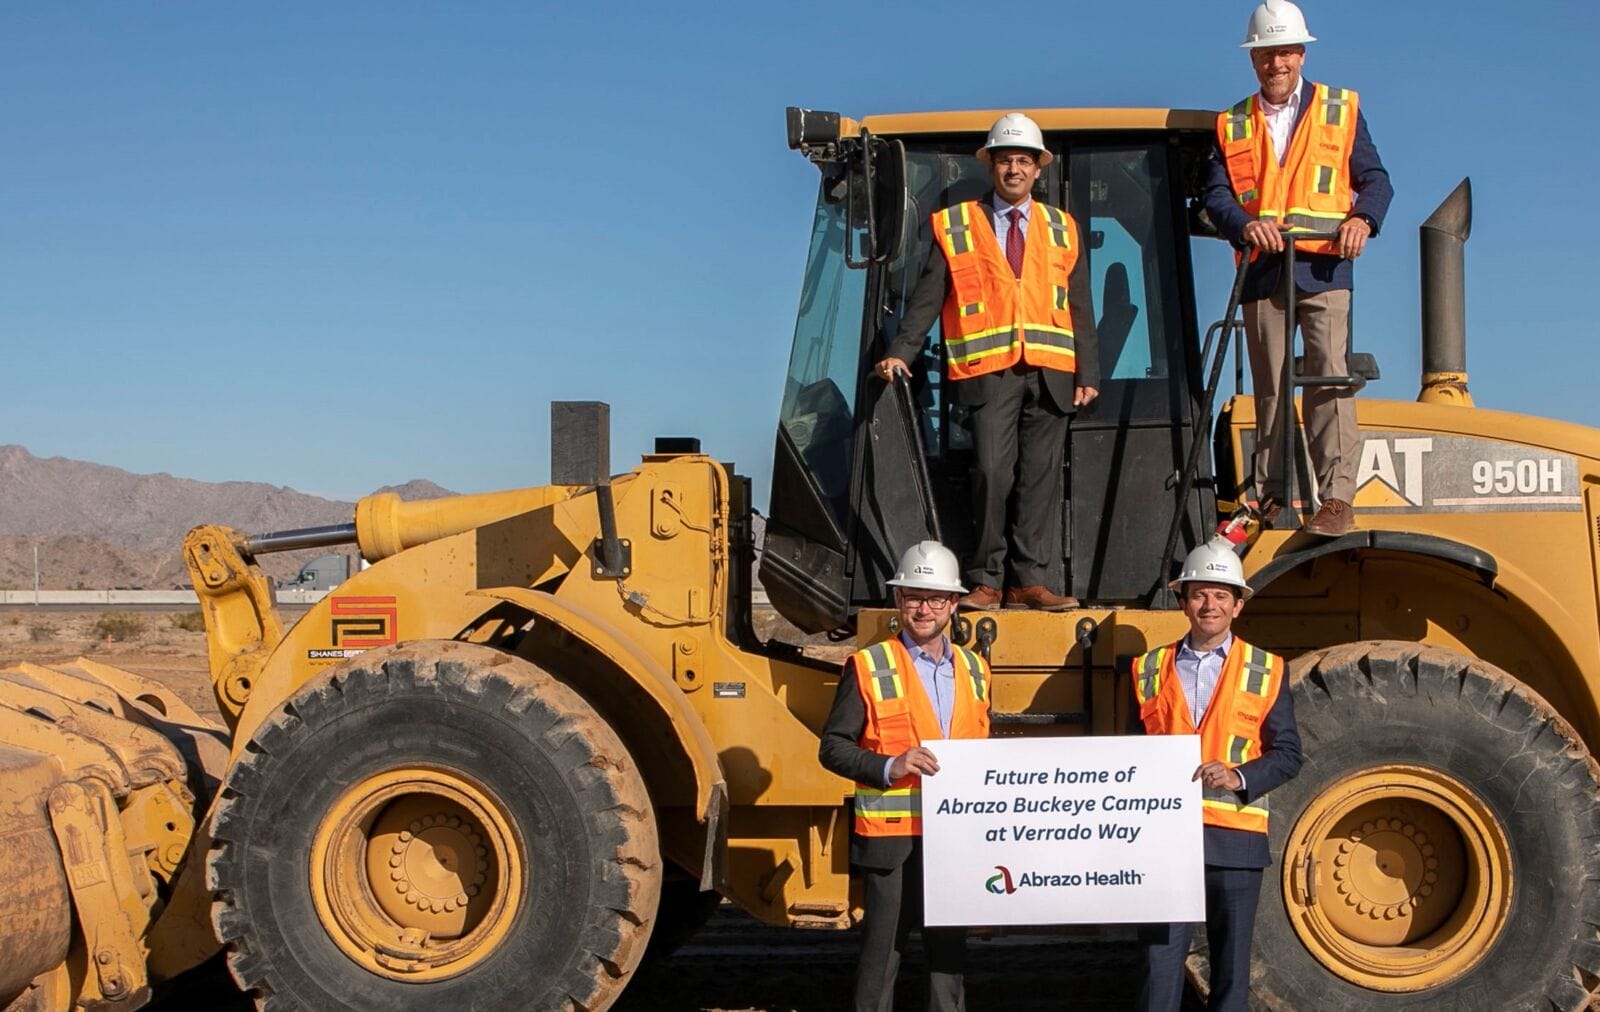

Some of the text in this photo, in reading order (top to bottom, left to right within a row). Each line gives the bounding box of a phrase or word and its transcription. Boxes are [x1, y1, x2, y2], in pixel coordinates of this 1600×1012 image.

[1356, 438, 1432, 507] AT
[1472, 459, 1562, 495] 950H
[309, 650, 343, 658] SHANES
[984, 766, 1137, 786] Future home of
[936, 795, 1182, 817] Abrazo Buckeye Campus
[985, 823, 1141, 844] at Verrado Way
[1018, 871, 1082, 888] Abrazo
